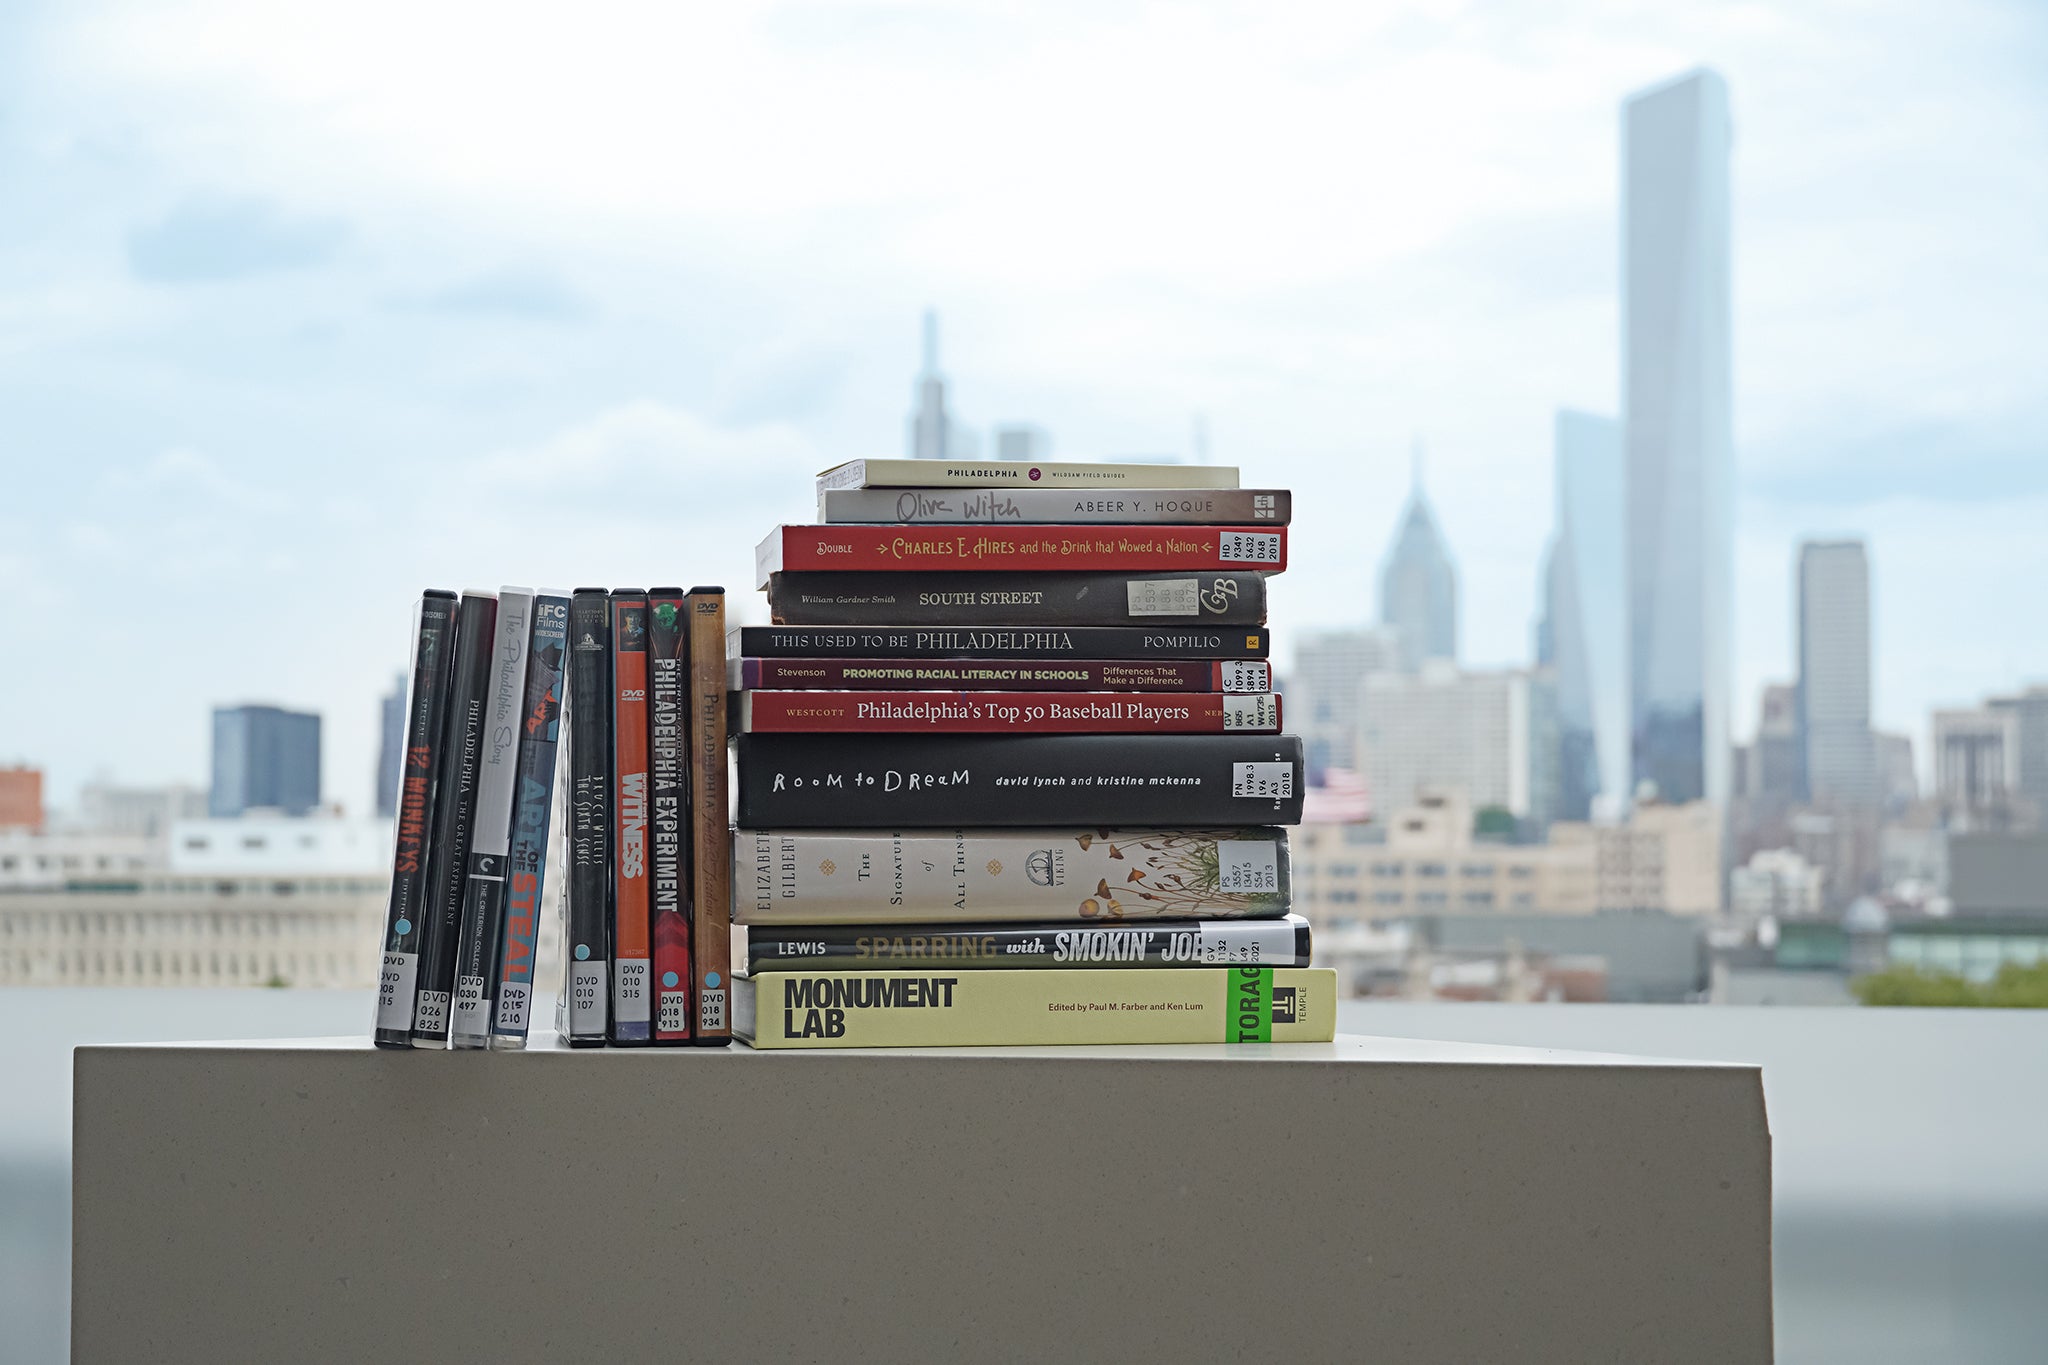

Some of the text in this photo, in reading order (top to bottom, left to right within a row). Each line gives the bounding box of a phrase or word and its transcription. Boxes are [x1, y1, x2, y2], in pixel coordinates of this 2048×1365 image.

[947, 469, 1018, 478] PHILADELPHIA
[896, 491, 953, 522] Olive
[1074, 501, 1214, 513] ABEER Y. HOQUE
[892, 537, 1198, 559] CHARLES E. HIRES and the Drink that Wowed Nation
[1222, 544, 1230, 558] HD
[1234, 535, 1242, 558] 9349
[1245, 536, 1254, 559] S632
[1257, 540, 1266, 559] D68
[1268, 537, 1277, 560] 2018
[801, 594, 896, 604] William Gardner Smith
[919, 591, 1043, 606] SOUTH STREET
[536, 616, 565, 629] Films
[771, 632, 1074, 650] THIS USED TO BE PHILADELPHIA
[1143, 635, 1221, 648] POMPILIO
[777, 667, 826, 677] Stevenson
[843, 668, 1089, 680] PROMOTING RACIAL LITERACY IN SCHOOLS
[1103, 667, 1177, 676] Differences That
[488, 607, 525, 766] The Philadelphia Story
[1103, 676, 1184, 685] Make Difference
[1247, 669, 1255, 691] S894
[1259, 669, 1267, 690] 2014
[418, 698, 428, 736] SPECIAL
[786, 708, 844, 717] WESTCOTT
[857, 701, 1190, 723] Philadelphia's Top 50 Baseball Players
[1256, 695, 1265, 726] W4735
[1268, 704, 1276, 726] 2013
[1224, 711, 1232, 727] GV
[1235, 710, 1243, 727] 865
[1246, 714, 1254, 726] A1
[703, 694, 719, 809] PHILADELPHIA
[576, 774, 591, 796] THE
[654, 658, 678, 912] PHILADELPHIA EXPERIMENT
[854, 772, 875, 787] to
[995, 776, 1201, 787] david lynch and kristine mckenna
[1246, 764, 1254, 795] 1998.3
[1282, 772, 1290, 795] 2018
[1235, 783, 1243, 796] PN
[1270, 782, 1278, 795] A3
[396, 743, 431, 873] 12 MONKEYS
[446, 699, 480, 926] PHILADELPHIA THE GREAT EXPERIMENT
[622, 773, 643, 879] WITNESS
[592, 824, 604, 864] WILLIS
[515, 840, 529, 872] THE
[526, 851, 539, 873] OF
[756, 829, 771, 911] ELIZABETH
[781, 837, 796, 899] GILBERT
[858, 853, 870, 882] THE
[890, 832, 903, 905] SIGNATURE
[921, 860, 935, 872] of
[1055, 848, 1065, 886] VIKING
[1221, 876, 1230, 888] PS
[1232, 865, 1241, 888] 3557
[1254, 871, 1263, 888] S54
[1265, 864, 1274, 888] 2013
[954, 882, 966, 910] ALL
[476, 883, 489, 937] THE CRITERION
[503, 872, 537, 982] STEAL
[778, 942, 826, 955] LEWIS
[855, 932, 1202, 962] SPARRING with SMOKIN' JOE
[1206, 946, 1215, 961] GV
[1218, 940, 1227, 961] 1132
[1240, 947, 1248, 962] L49
[1251, 941, 1260, 962] 2021
[383, 956, 405, 966] DVD
[622, 965, 645, 974] DVD
[461, 977, 483, 986] DVD
[576, 976, 598, 986] DVD
[622, 977, 641, 986] 010
[422, 991, 448, 1003] DVD
[459, 989, 478, 998] 030
[504, 989, 526, 999] DVD
[575, 988, 594, 998] 010
[622, 989, 640, 998] 315
[661, 995, 684, 1005] DVD
[702, 993, 724, 1003] DVD
[784, 977, 958, 1008] MONUMENT
[420, 1005, 441, 1016] 026
[458, 1001, 477, 1011] 497
[502, 1001, 524, 1010] 015
[576, 1000, 594, 1010] 107
[702, 1006, 720, 1015] 018
[1048, 1002, 1204, 1013] Edited by Paul M. Farber and Ken Lum
[1298, 987, 1307, 1022] TEMPLE
[500, 1013, 521, 1024] 210
[661, 1008, 680, 1017] 018
[418, 1019, 440, 1030] 825
[661, 1019, 680, 1028] 913
[702, 1018, 720, 1027] 934
[784, 1008, 846, 1039] LAB
